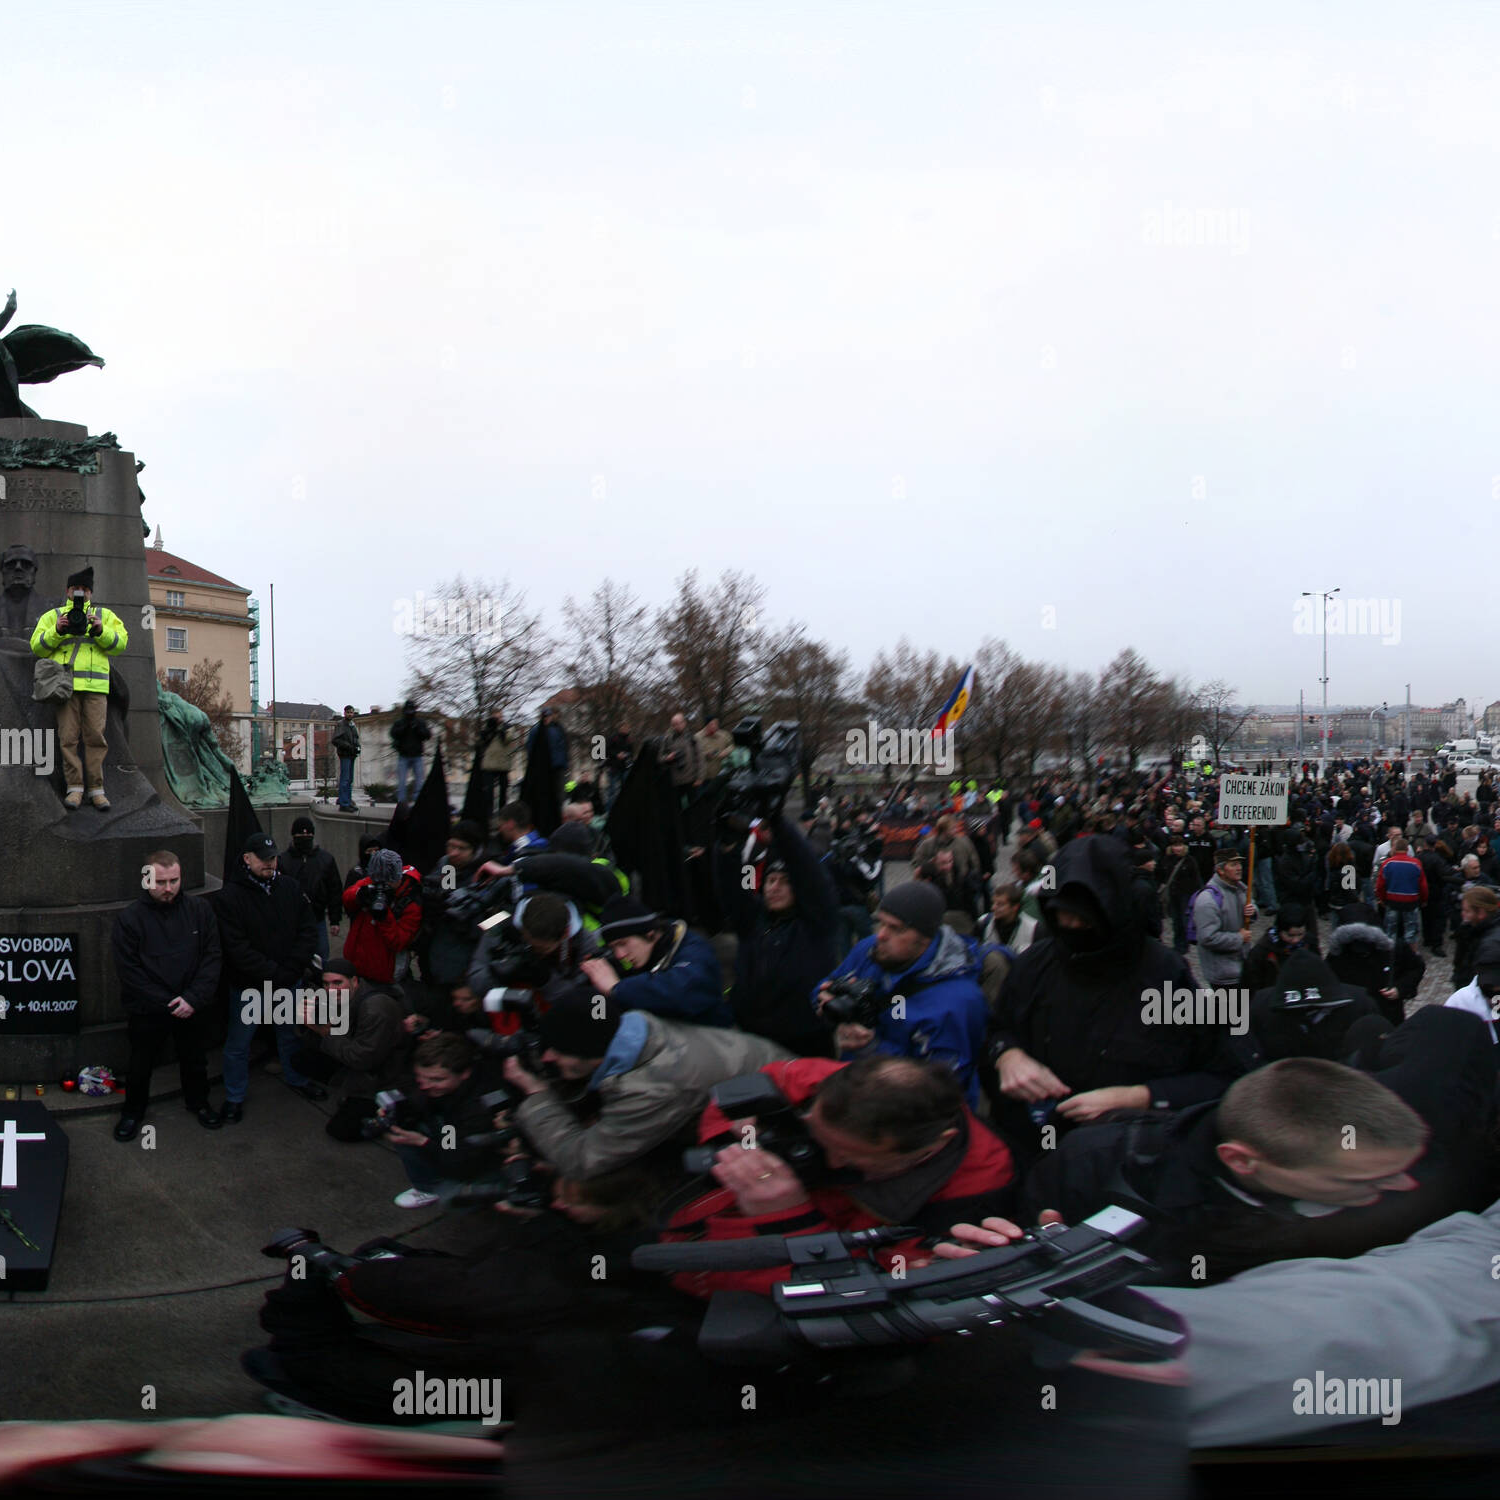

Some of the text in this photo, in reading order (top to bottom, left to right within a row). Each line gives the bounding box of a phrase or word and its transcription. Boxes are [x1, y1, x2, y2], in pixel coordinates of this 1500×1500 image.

[1225, 779, 1285, 797] CHCEME ZÁKON
[1223, 804, 1277, 820] O REFERENDU
[27, 999, 78, 1012] 10.11.2007
